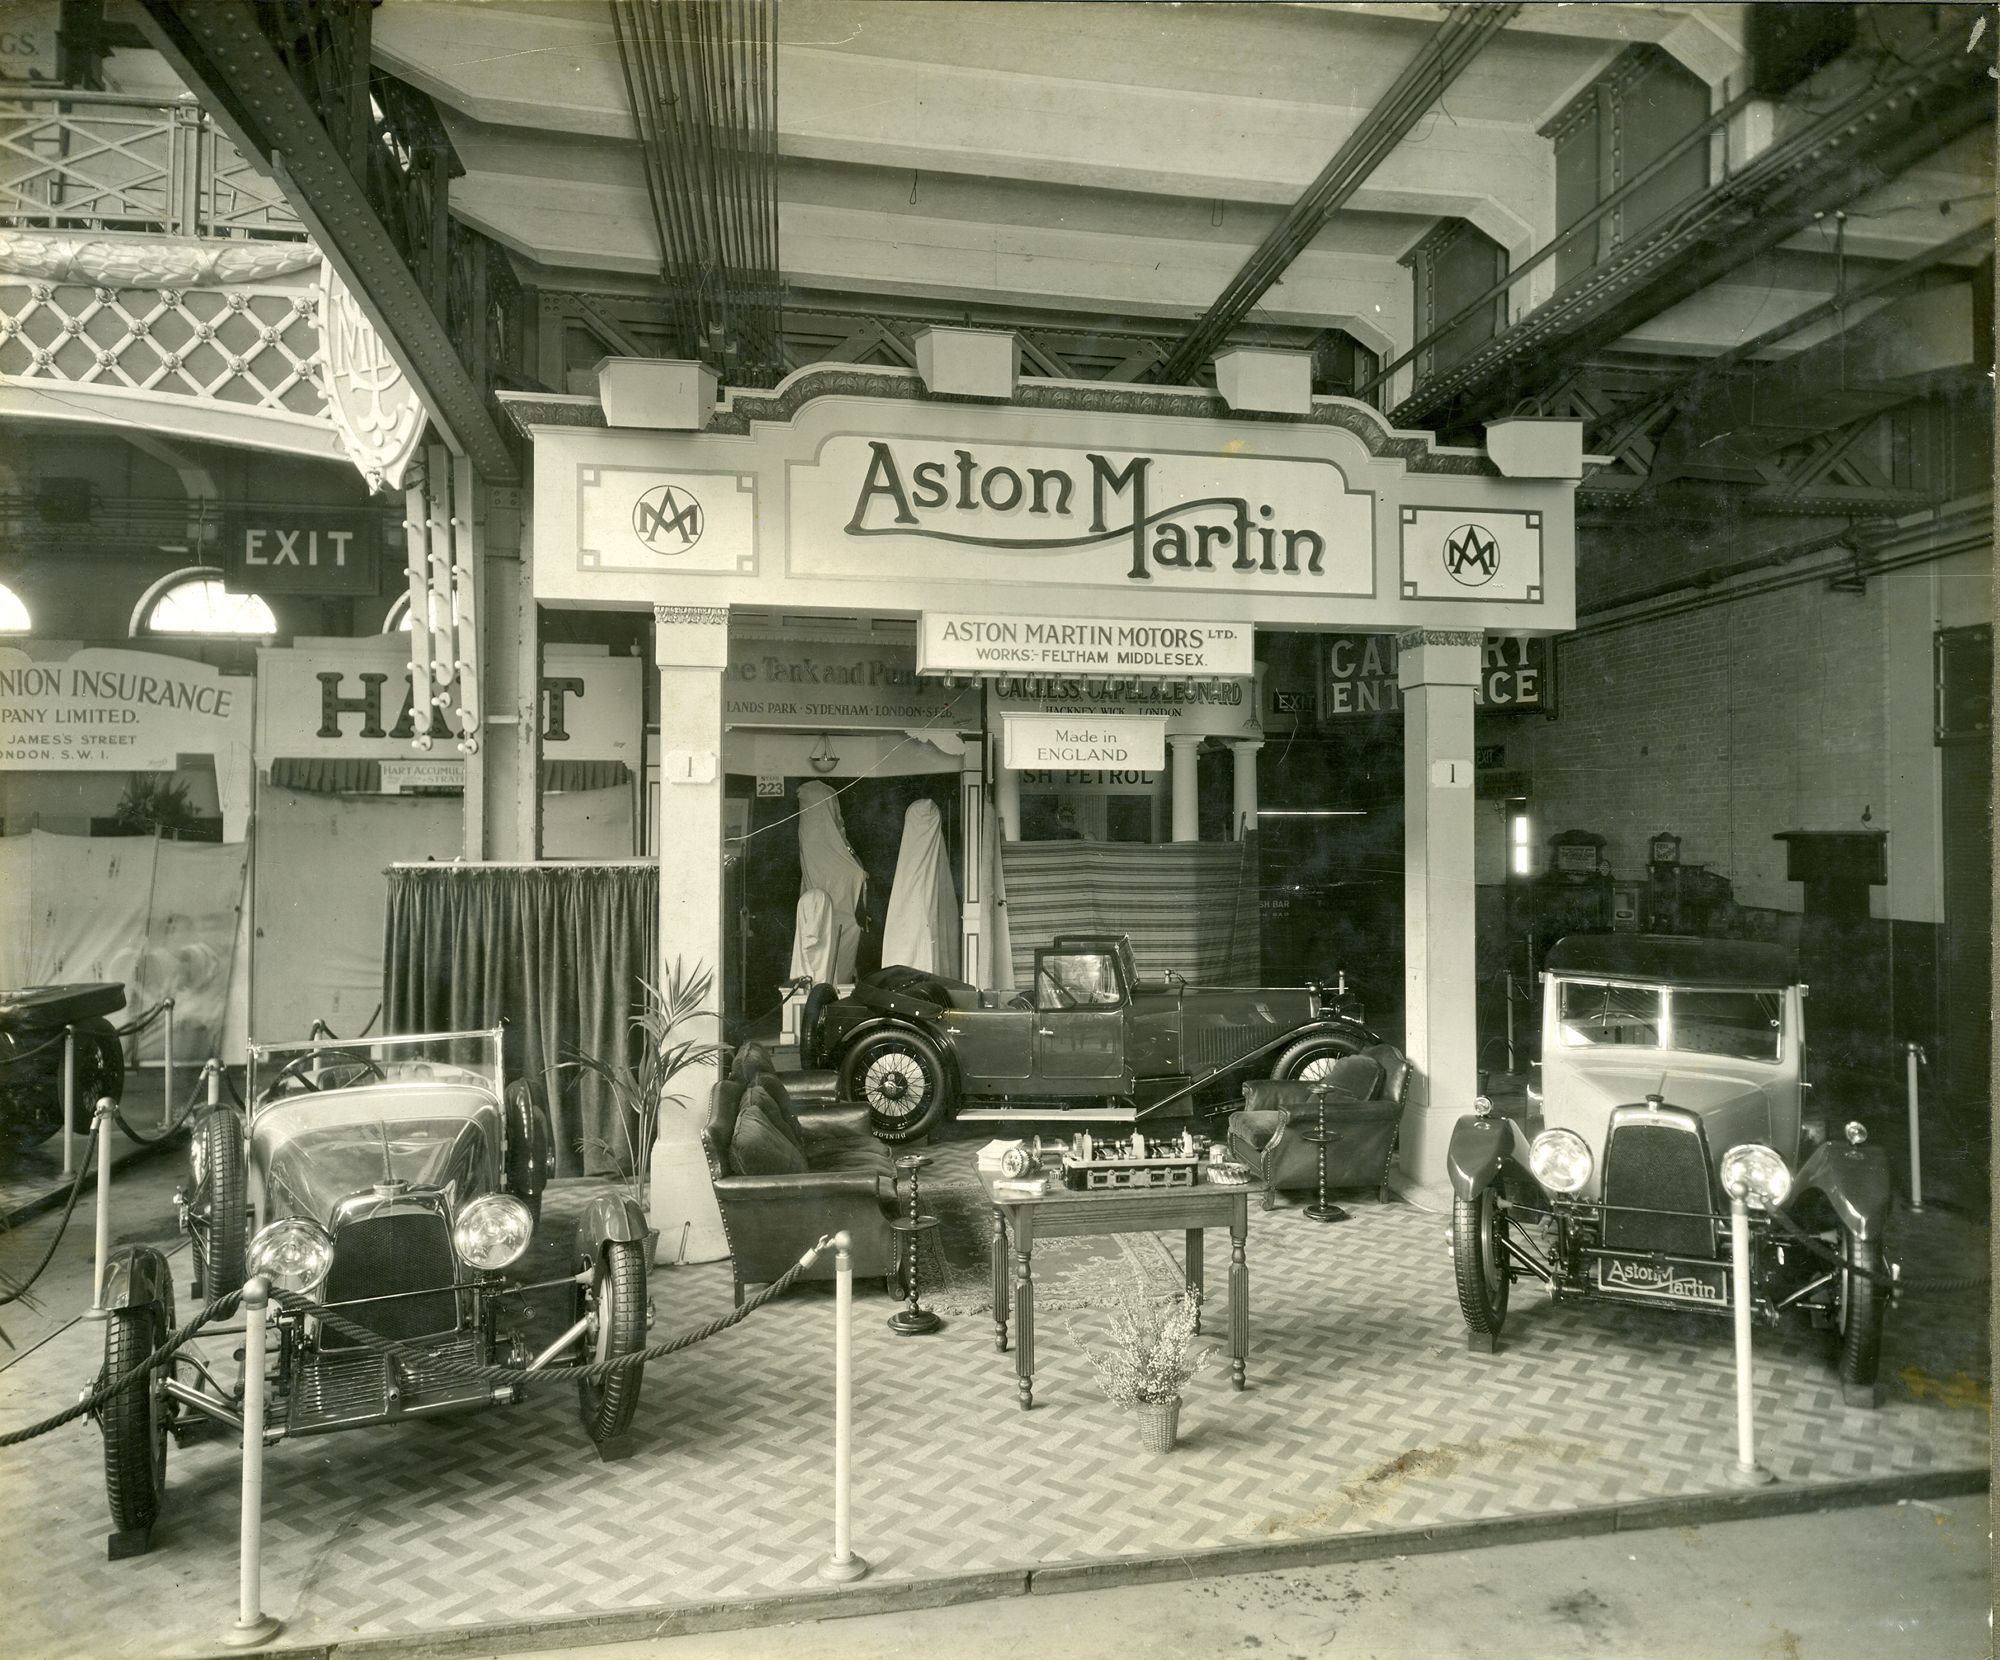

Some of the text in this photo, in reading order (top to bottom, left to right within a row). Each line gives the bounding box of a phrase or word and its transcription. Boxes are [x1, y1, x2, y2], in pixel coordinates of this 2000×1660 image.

[844, 440, 1325, 579] Aston Martin
[245, 529, 353, 566] EXIT
[942, 621, 1238, 649] ASTON MARTIN MOTORS LTD.
[1041, 650, 1109, 664] FELTHAM
[1116, 652, 1208, 667] MIDDLESEX.
[71, 670, 233, 719] INSURANCE
[1279, 694, 1314, 709] EXIT
[55, 709, 140, 724] LIMITED.
[768, 702, 797, 714] PARK
[805, 703, 869, 716] SYDENHAM
[875, 705, 922, 716] LONDON
[8, 733, 137, 745] JAMES'S STREET
[1055, 730, 1117, 744] Made in
[1037, 747, 1128, 762] ENGLAND
[383, 765, 411, 776] HART
[758, 782, 783, 796] 223
[1272, 900, 1290, 908] BAR
[873, 1130, 906, 1140] DUNLOP
[1607, 1259, 1657, 1282] Aston
